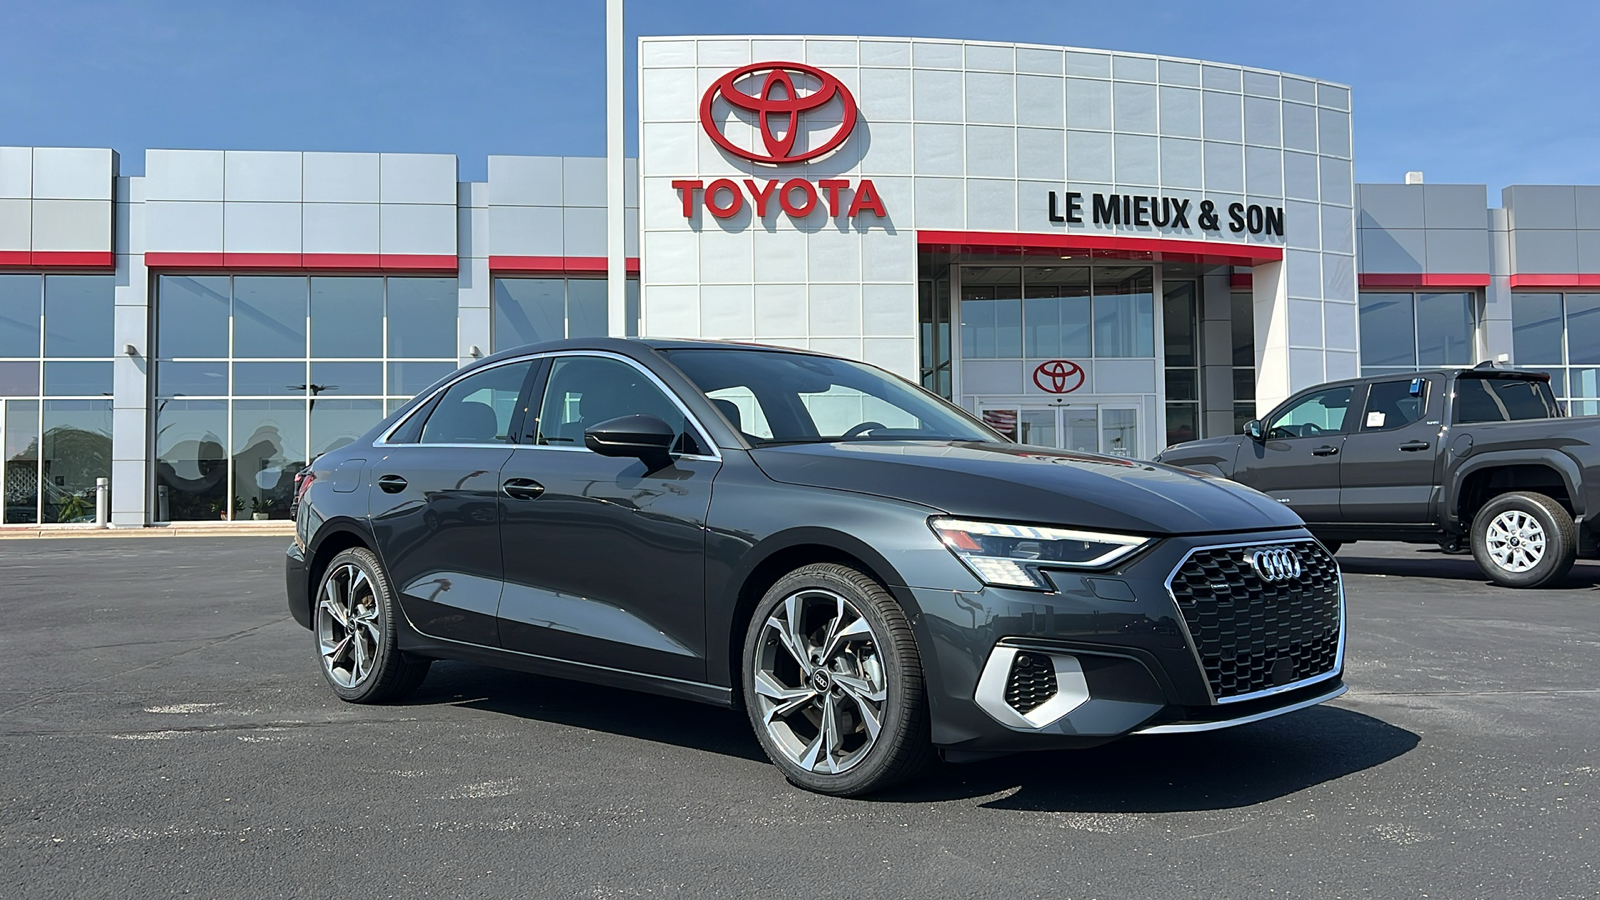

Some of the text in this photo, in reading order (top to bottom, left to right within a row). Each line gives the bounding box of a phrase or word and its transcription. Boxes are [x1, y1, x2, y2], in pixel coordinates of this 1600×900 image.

[672, 178, 886, 218] TOYOTA
[1048, 191, 1284, 236] LE MIEUX & SON
